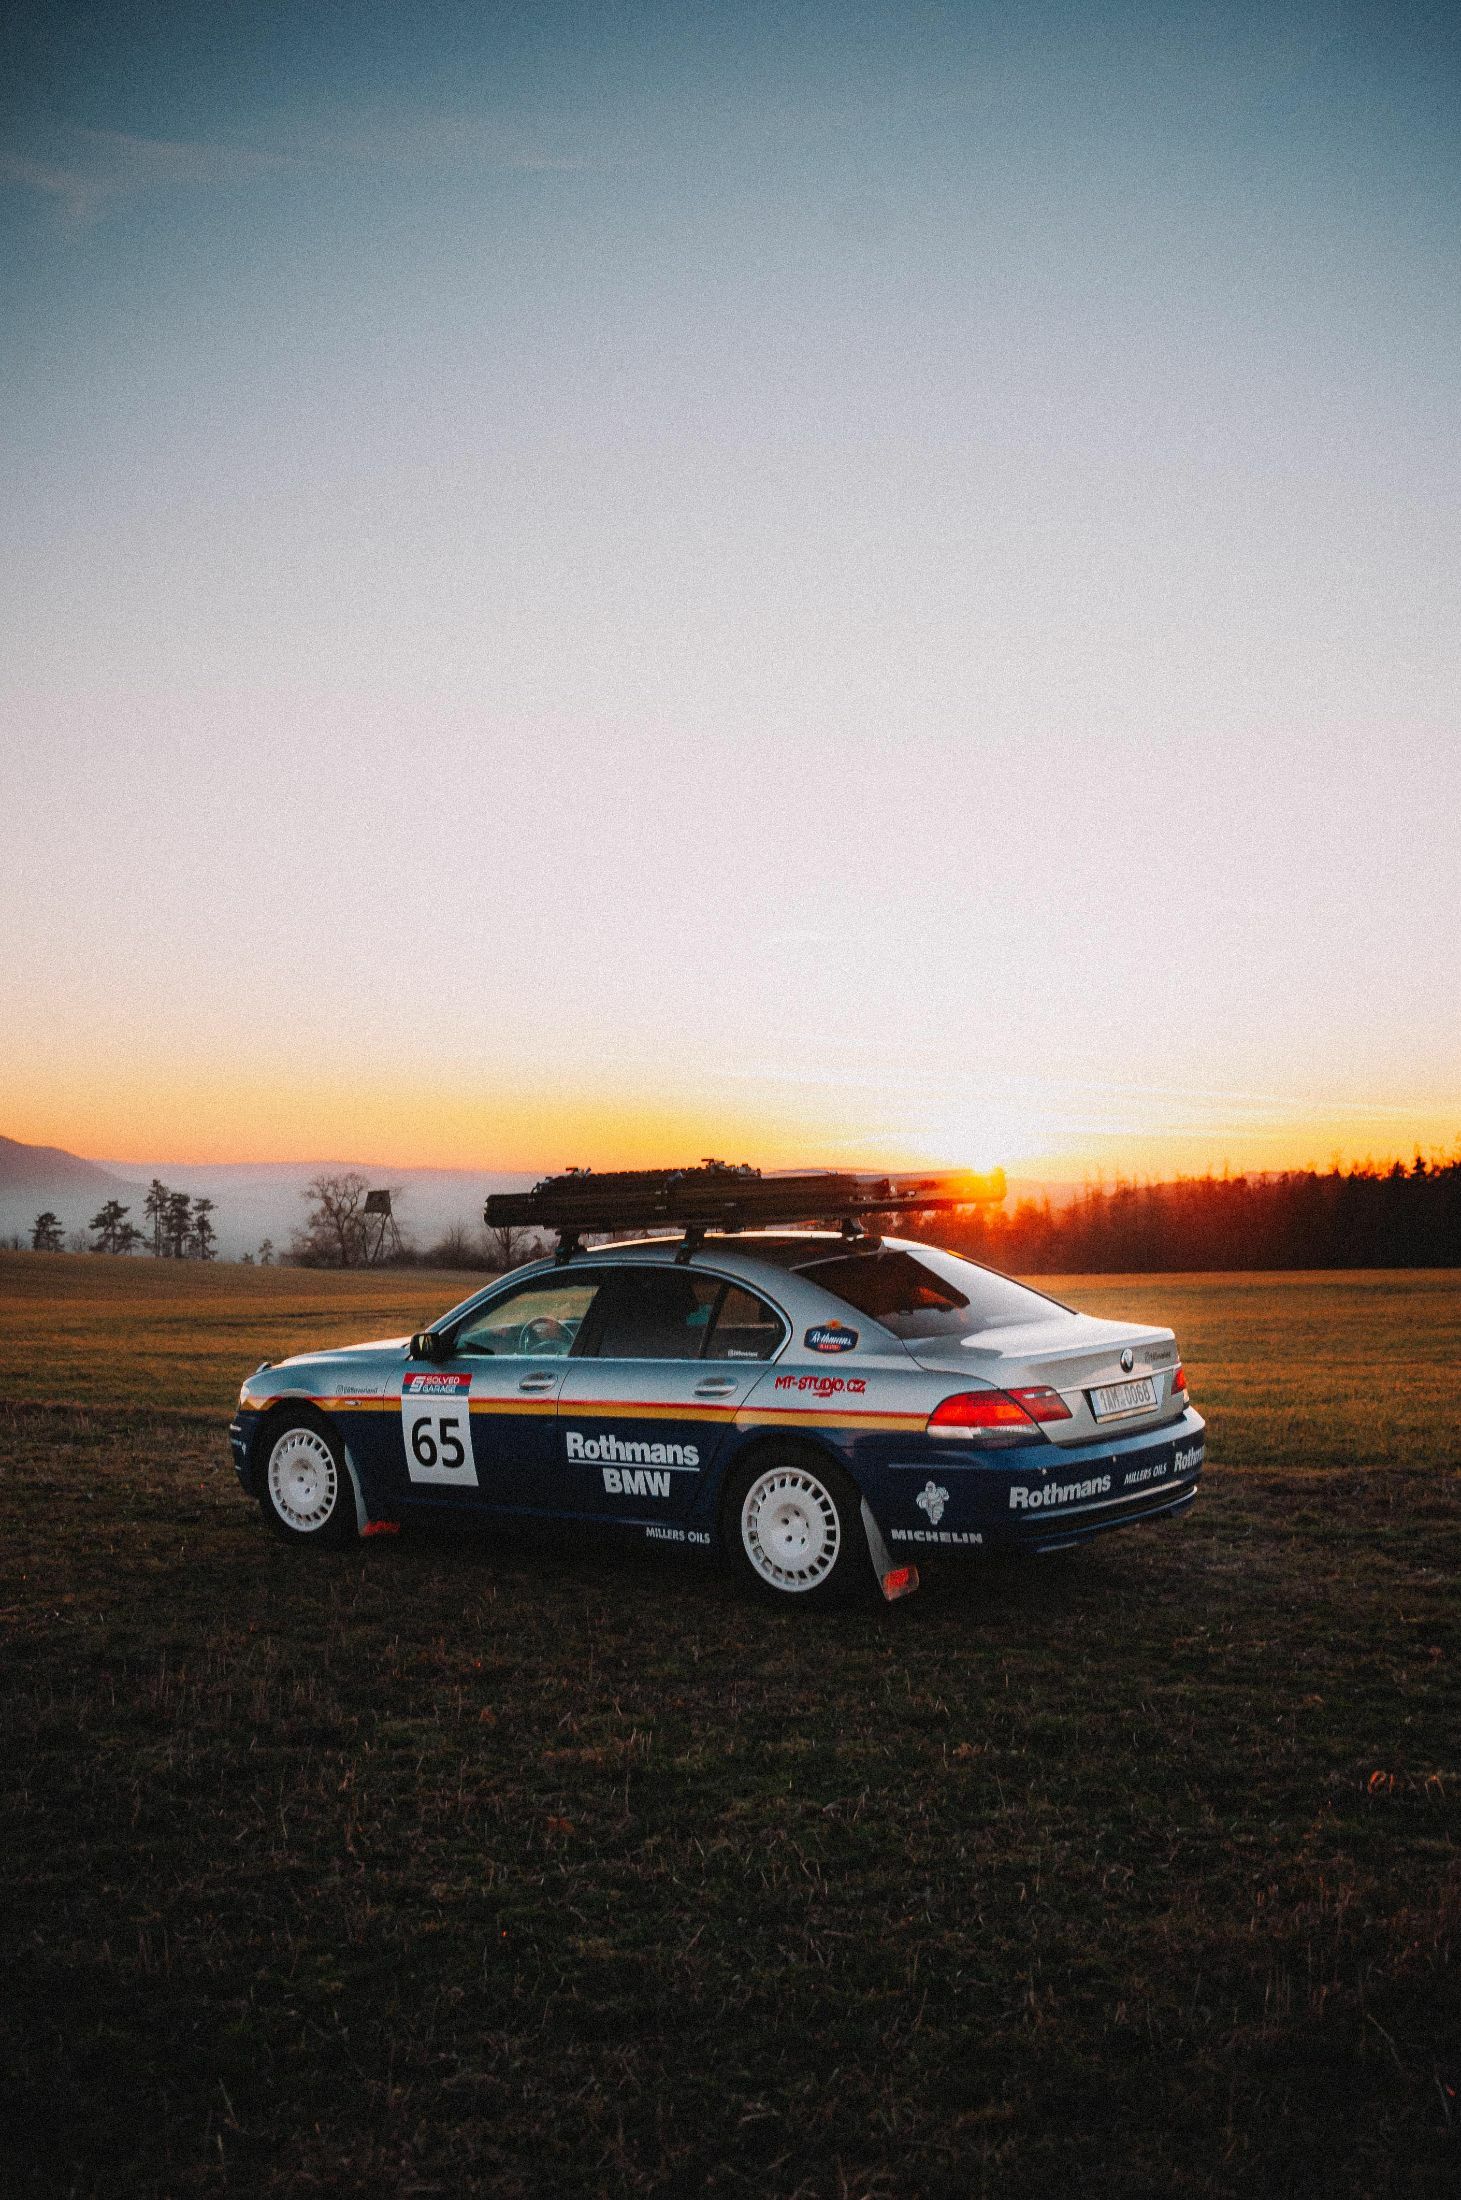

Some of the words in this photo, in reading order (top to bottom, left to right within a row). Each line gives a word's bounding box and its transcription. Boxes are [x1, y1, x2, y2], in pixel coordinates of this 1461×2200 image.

[422, 1384, 457, 1393] GARAGE
[424, 1376, 460, 1384] SOLVED
[411, 1416, 465, 1469] 65
[565, 1431, 700, 1467] Rothmans
[602, 1467, 671, 1498] BMW
[1123, 1468, 1152, 1486] MILLERS
[1152, 1462, 1169, 1479] OILS
[1008, 1473, 1112, 1509] Rothmans
[645, 1526, 686, 1542] MILLERS
[687, 1530, 712, 1545] OILS
[890, 1528, 983, 1544] MICHELIN
